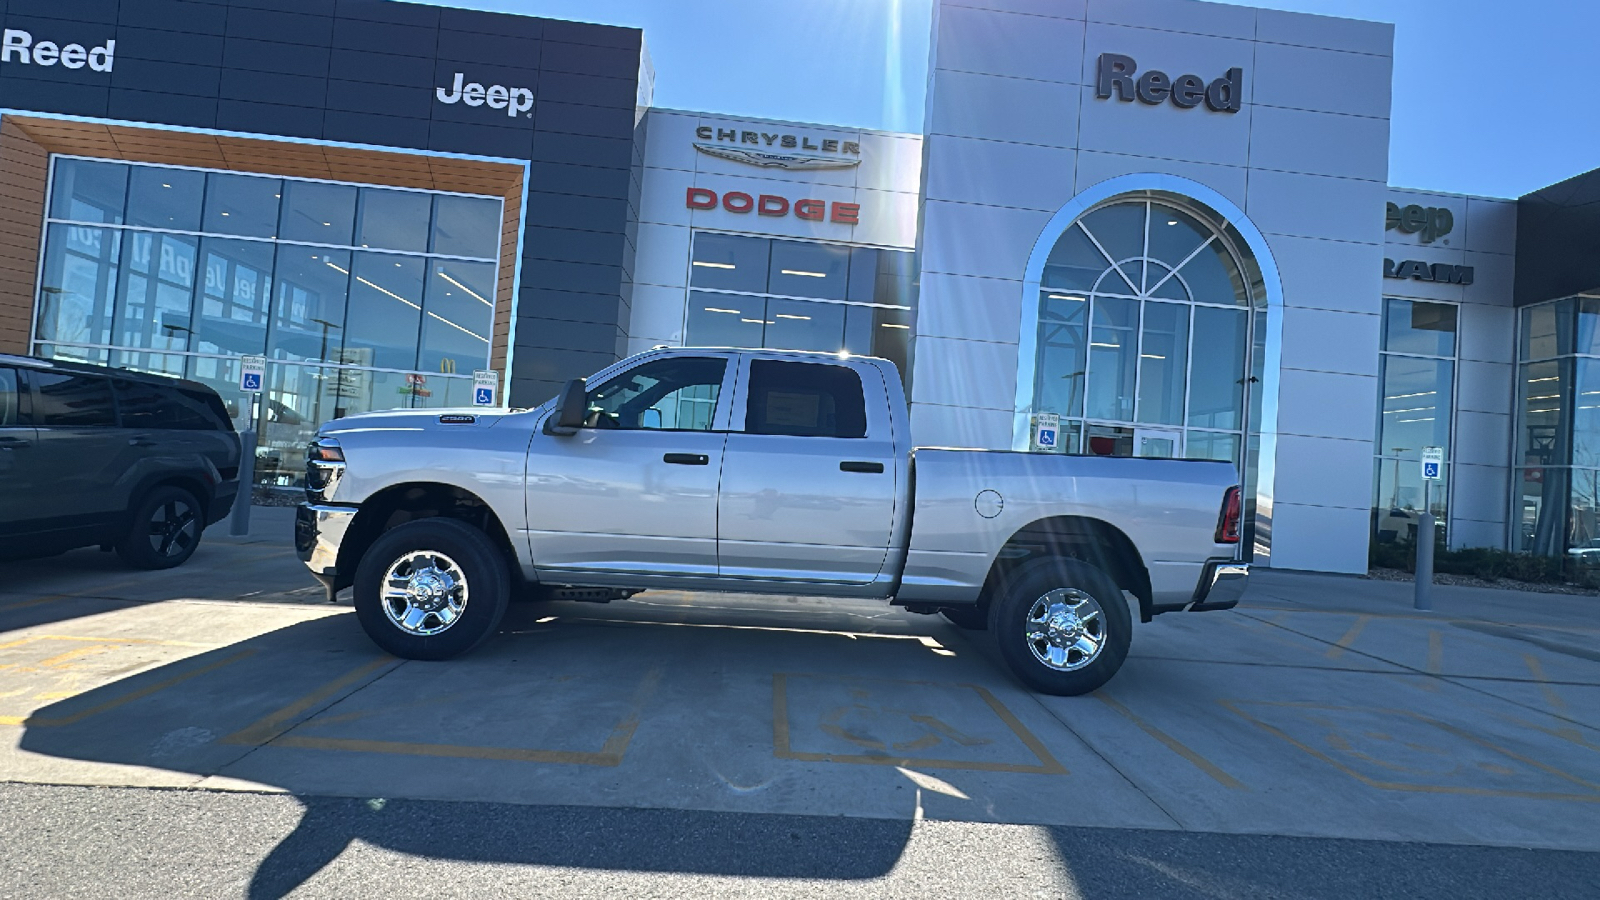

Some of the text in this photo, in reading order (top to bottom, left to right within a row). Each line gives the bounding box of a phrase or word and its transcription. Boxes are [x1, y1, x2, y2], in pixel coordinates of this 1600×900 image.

[1, 28, 115, 72] Reed
[437, 73, 533, 118] Jeep
[1097, 53, 1243, 113] Reed
[696, 126, 861, 154] CHRYSLER
[687, 187, 860, 225] DODGE
[1386, 201, 1454, 244] eep
